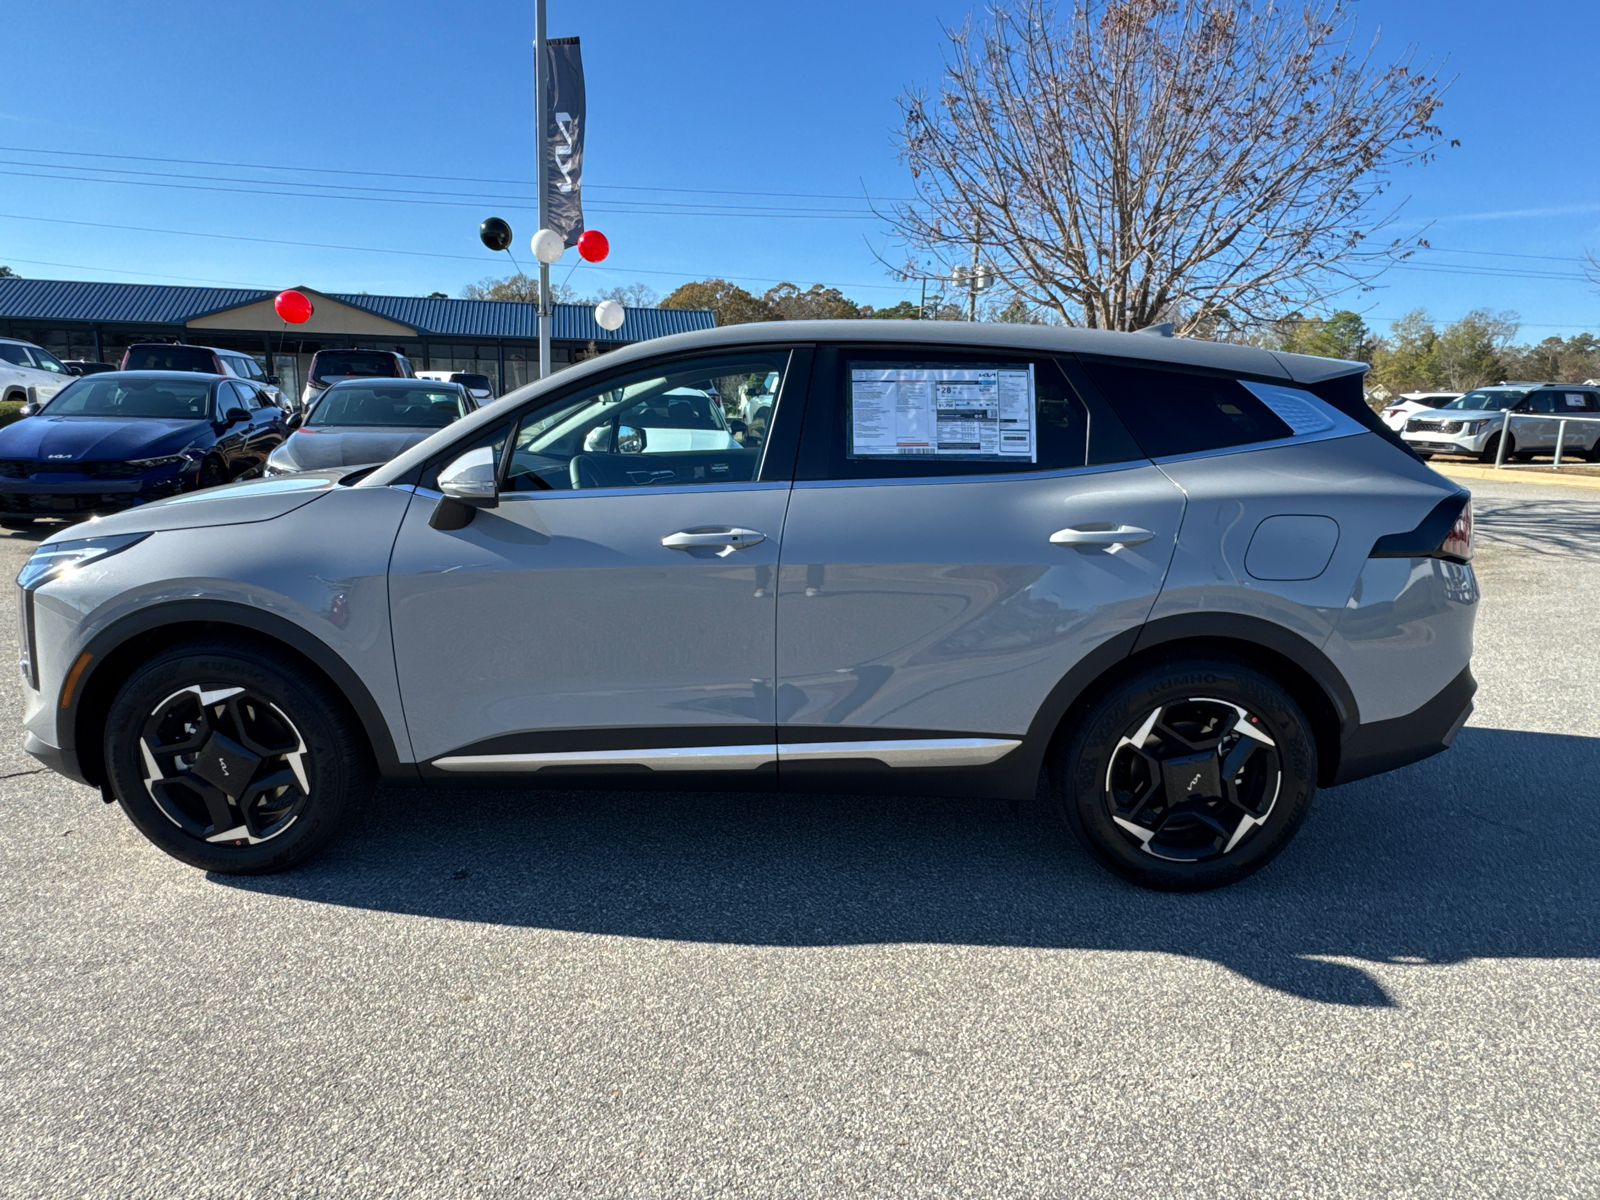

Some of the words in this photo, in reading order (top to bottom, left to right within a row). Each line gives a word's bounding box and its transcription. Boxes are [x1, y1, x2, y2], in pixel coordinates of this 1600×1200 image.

[555, 111, 573, 193] KIA
[941, 386, 952, 394] 28
[1147, 673, 1217, 695] KUMHO
[218, 757, 230, 776] KIA
[1186, 773, 1202, 791] KIA
